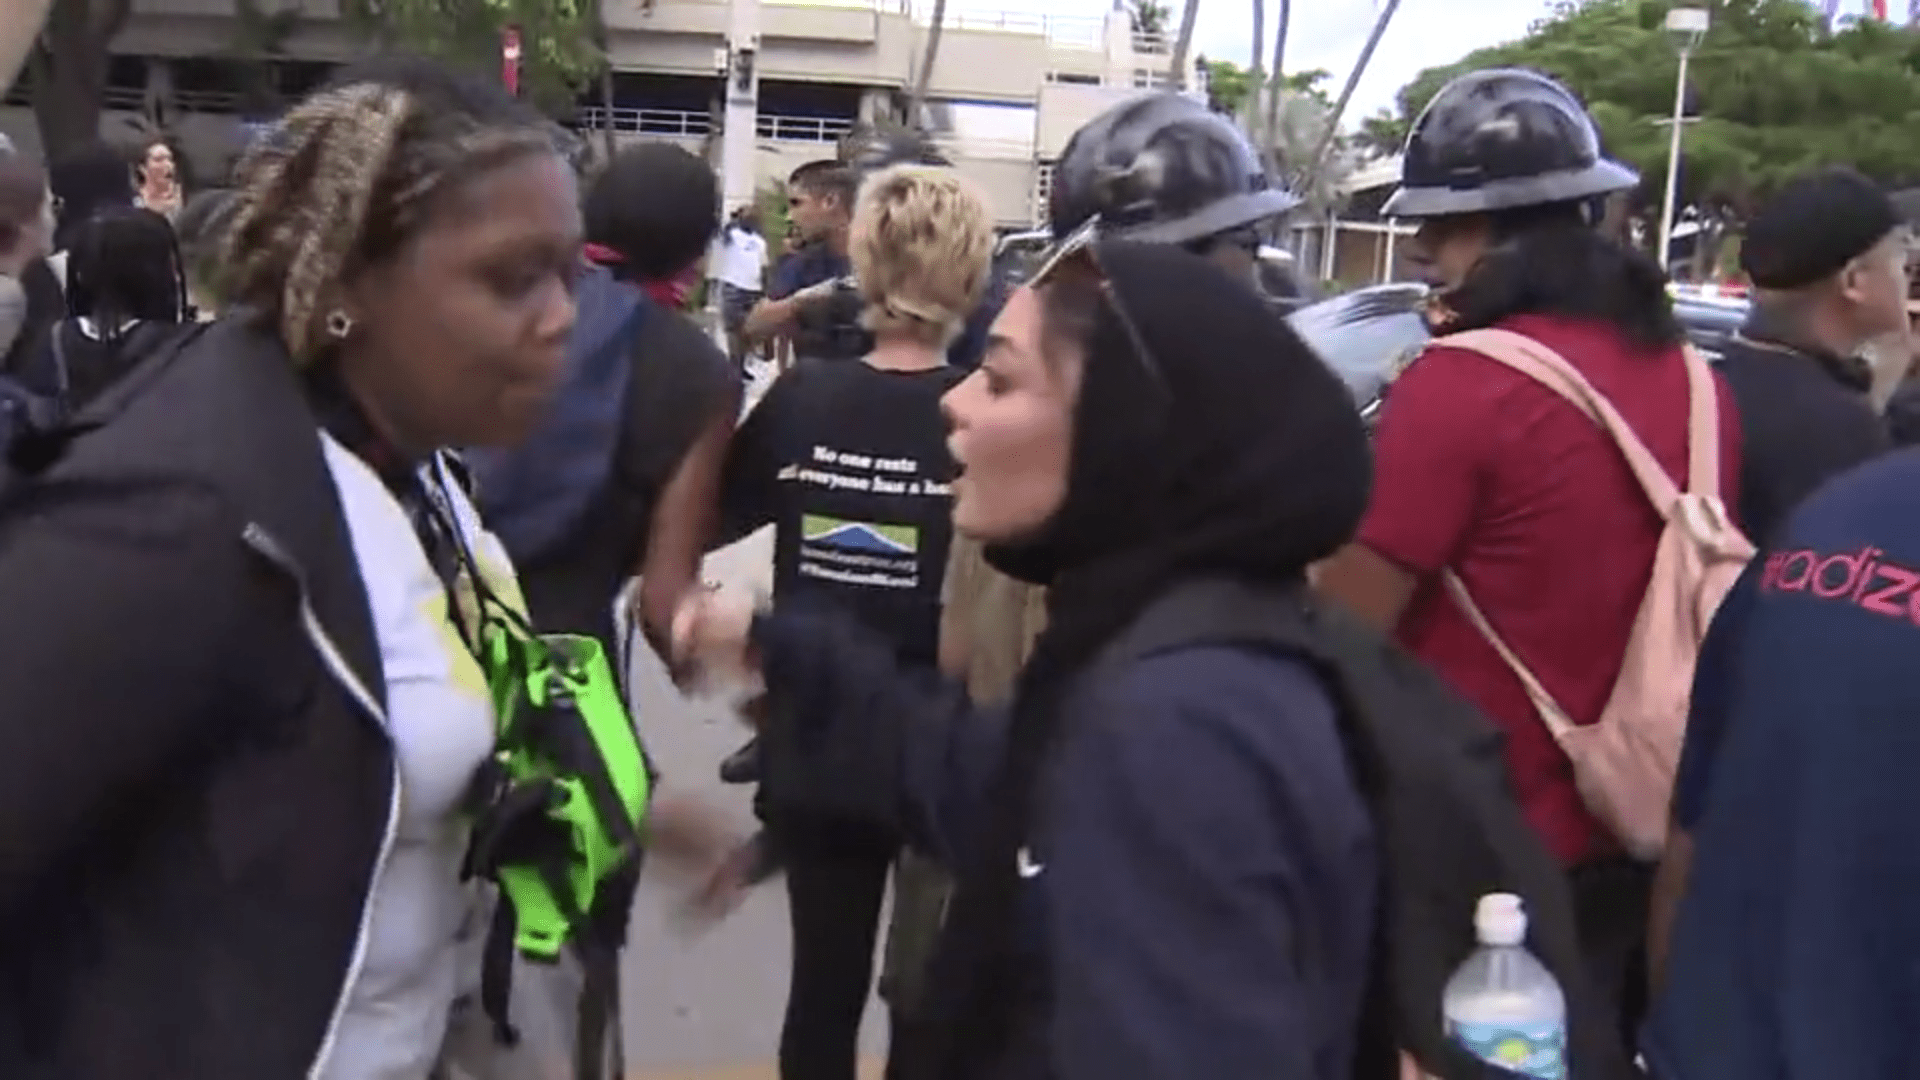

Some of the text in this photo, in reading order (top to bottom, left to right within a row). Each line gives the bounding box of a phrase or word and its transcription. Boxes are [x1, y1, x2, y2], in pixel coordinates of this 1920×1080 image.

[813, 445, 837, 462] No
[838, 453, 872, 468] one
[799, 468, 870, 490] everyone
[872, 475, 905, 493] has
[908, 481, 921, 494] a
